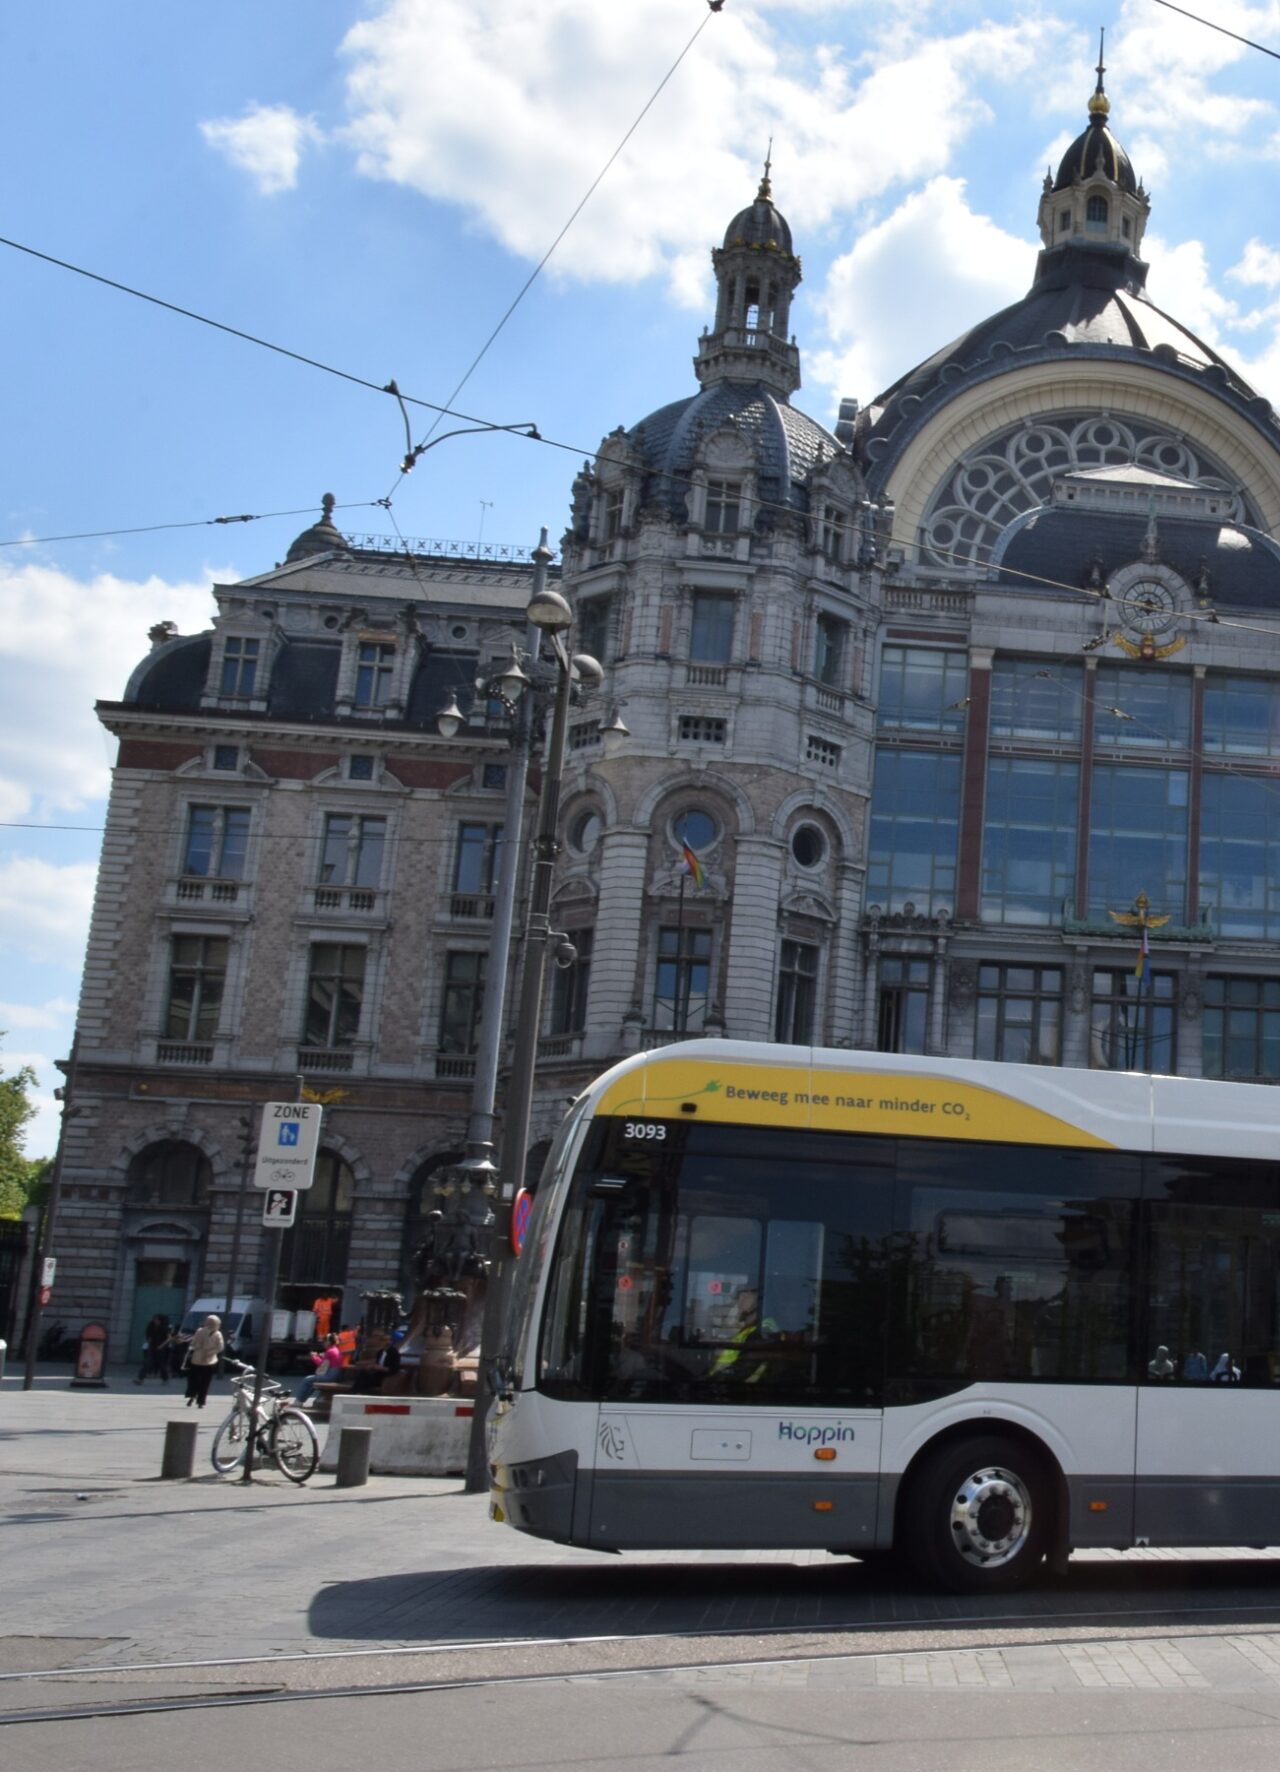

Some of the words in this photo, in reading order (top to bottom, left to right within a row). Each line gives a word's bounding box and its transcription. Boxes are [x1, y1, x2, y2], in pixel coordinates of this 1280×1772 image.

[725, 1085, 789, 1105] Beweeg
[794, 1092, 830, 1105] mee
[835, 1095, 874, 1109] naar
[879, 1096, 937, 1113] minder
[273, 1105, 311, 1119] ZONE
[624, 1122, 667, 1140] 3093
[777, 1420, 855, 1446] Hoppin
